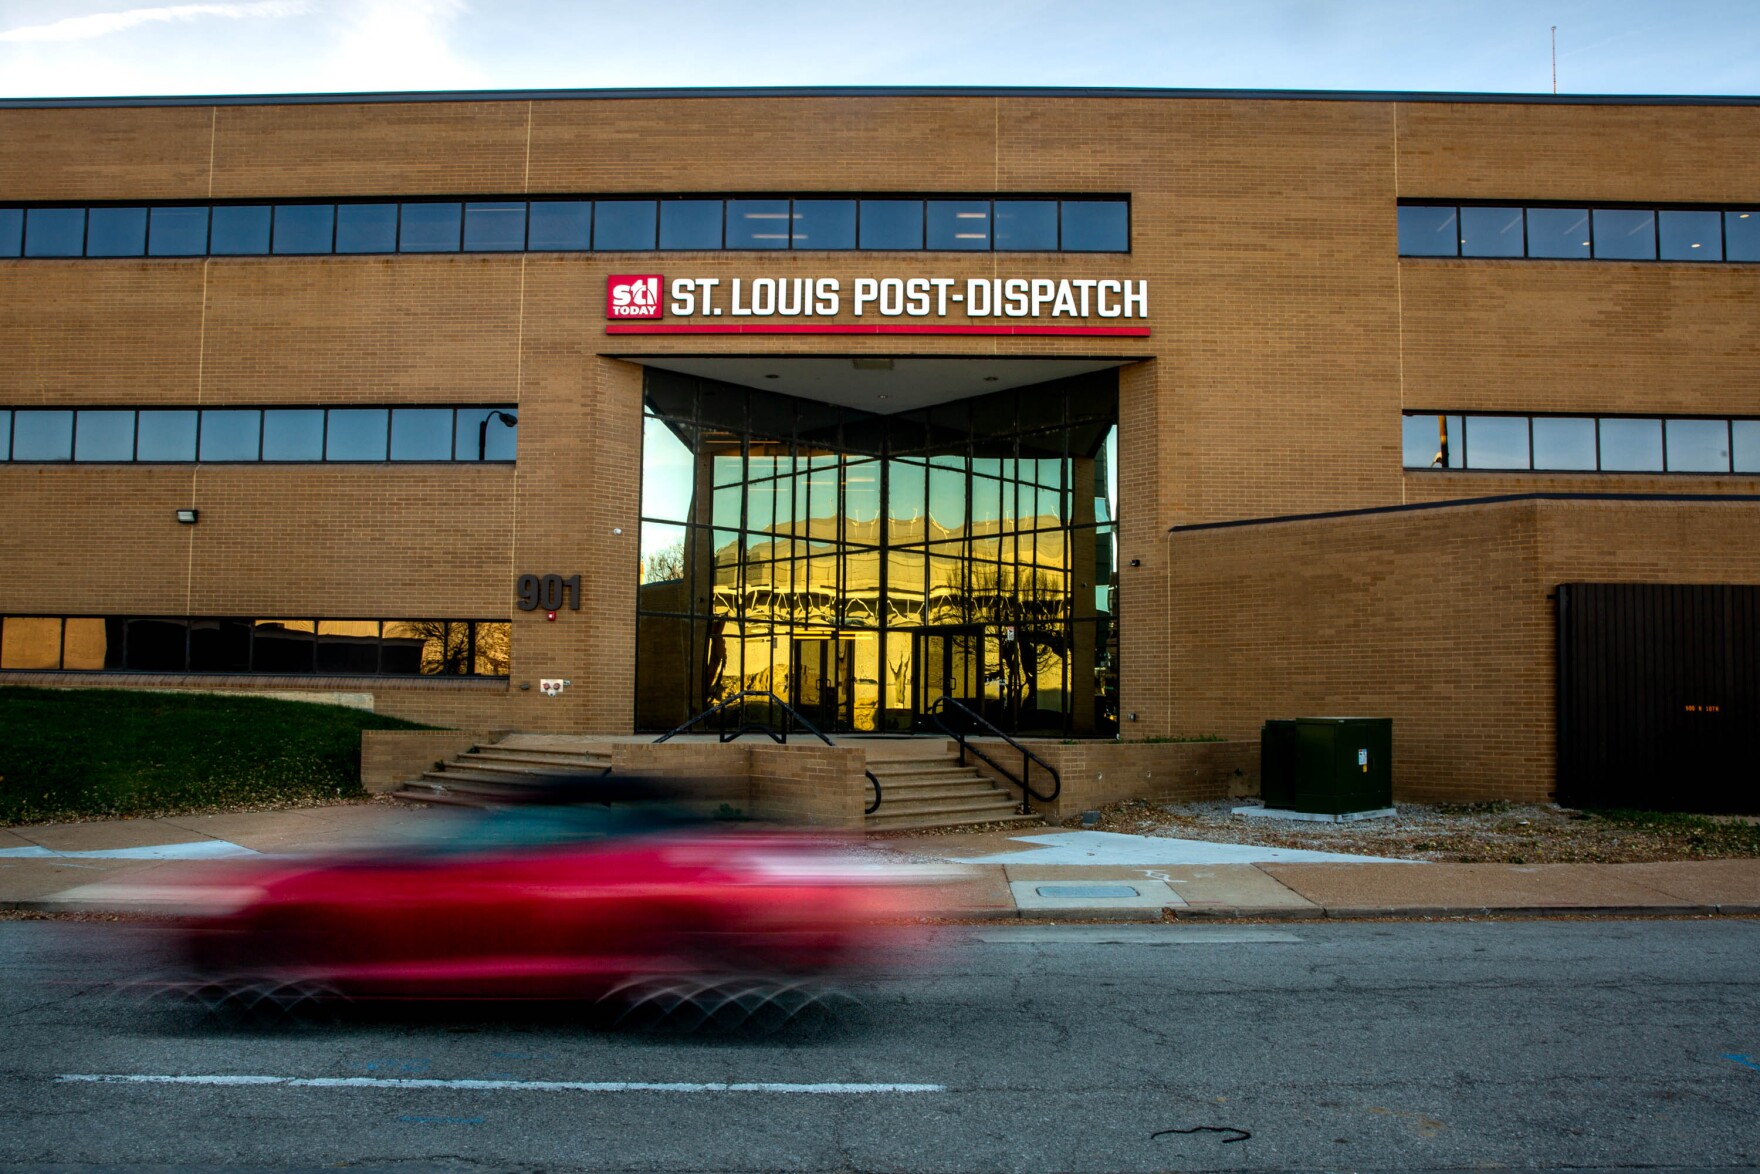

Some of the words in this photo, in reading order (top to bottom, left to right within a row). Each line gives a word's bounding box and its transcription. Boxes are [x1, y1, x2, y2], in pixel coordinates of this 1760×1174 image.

[613, 306, 656, 315] TODAY
[671, 278, 722, 316] ST.
[731, 278, 840, 316] LOUIS
[854, 278, 1149, 318] POST-DISPATCH
[517, 574, 581, 611] 901
